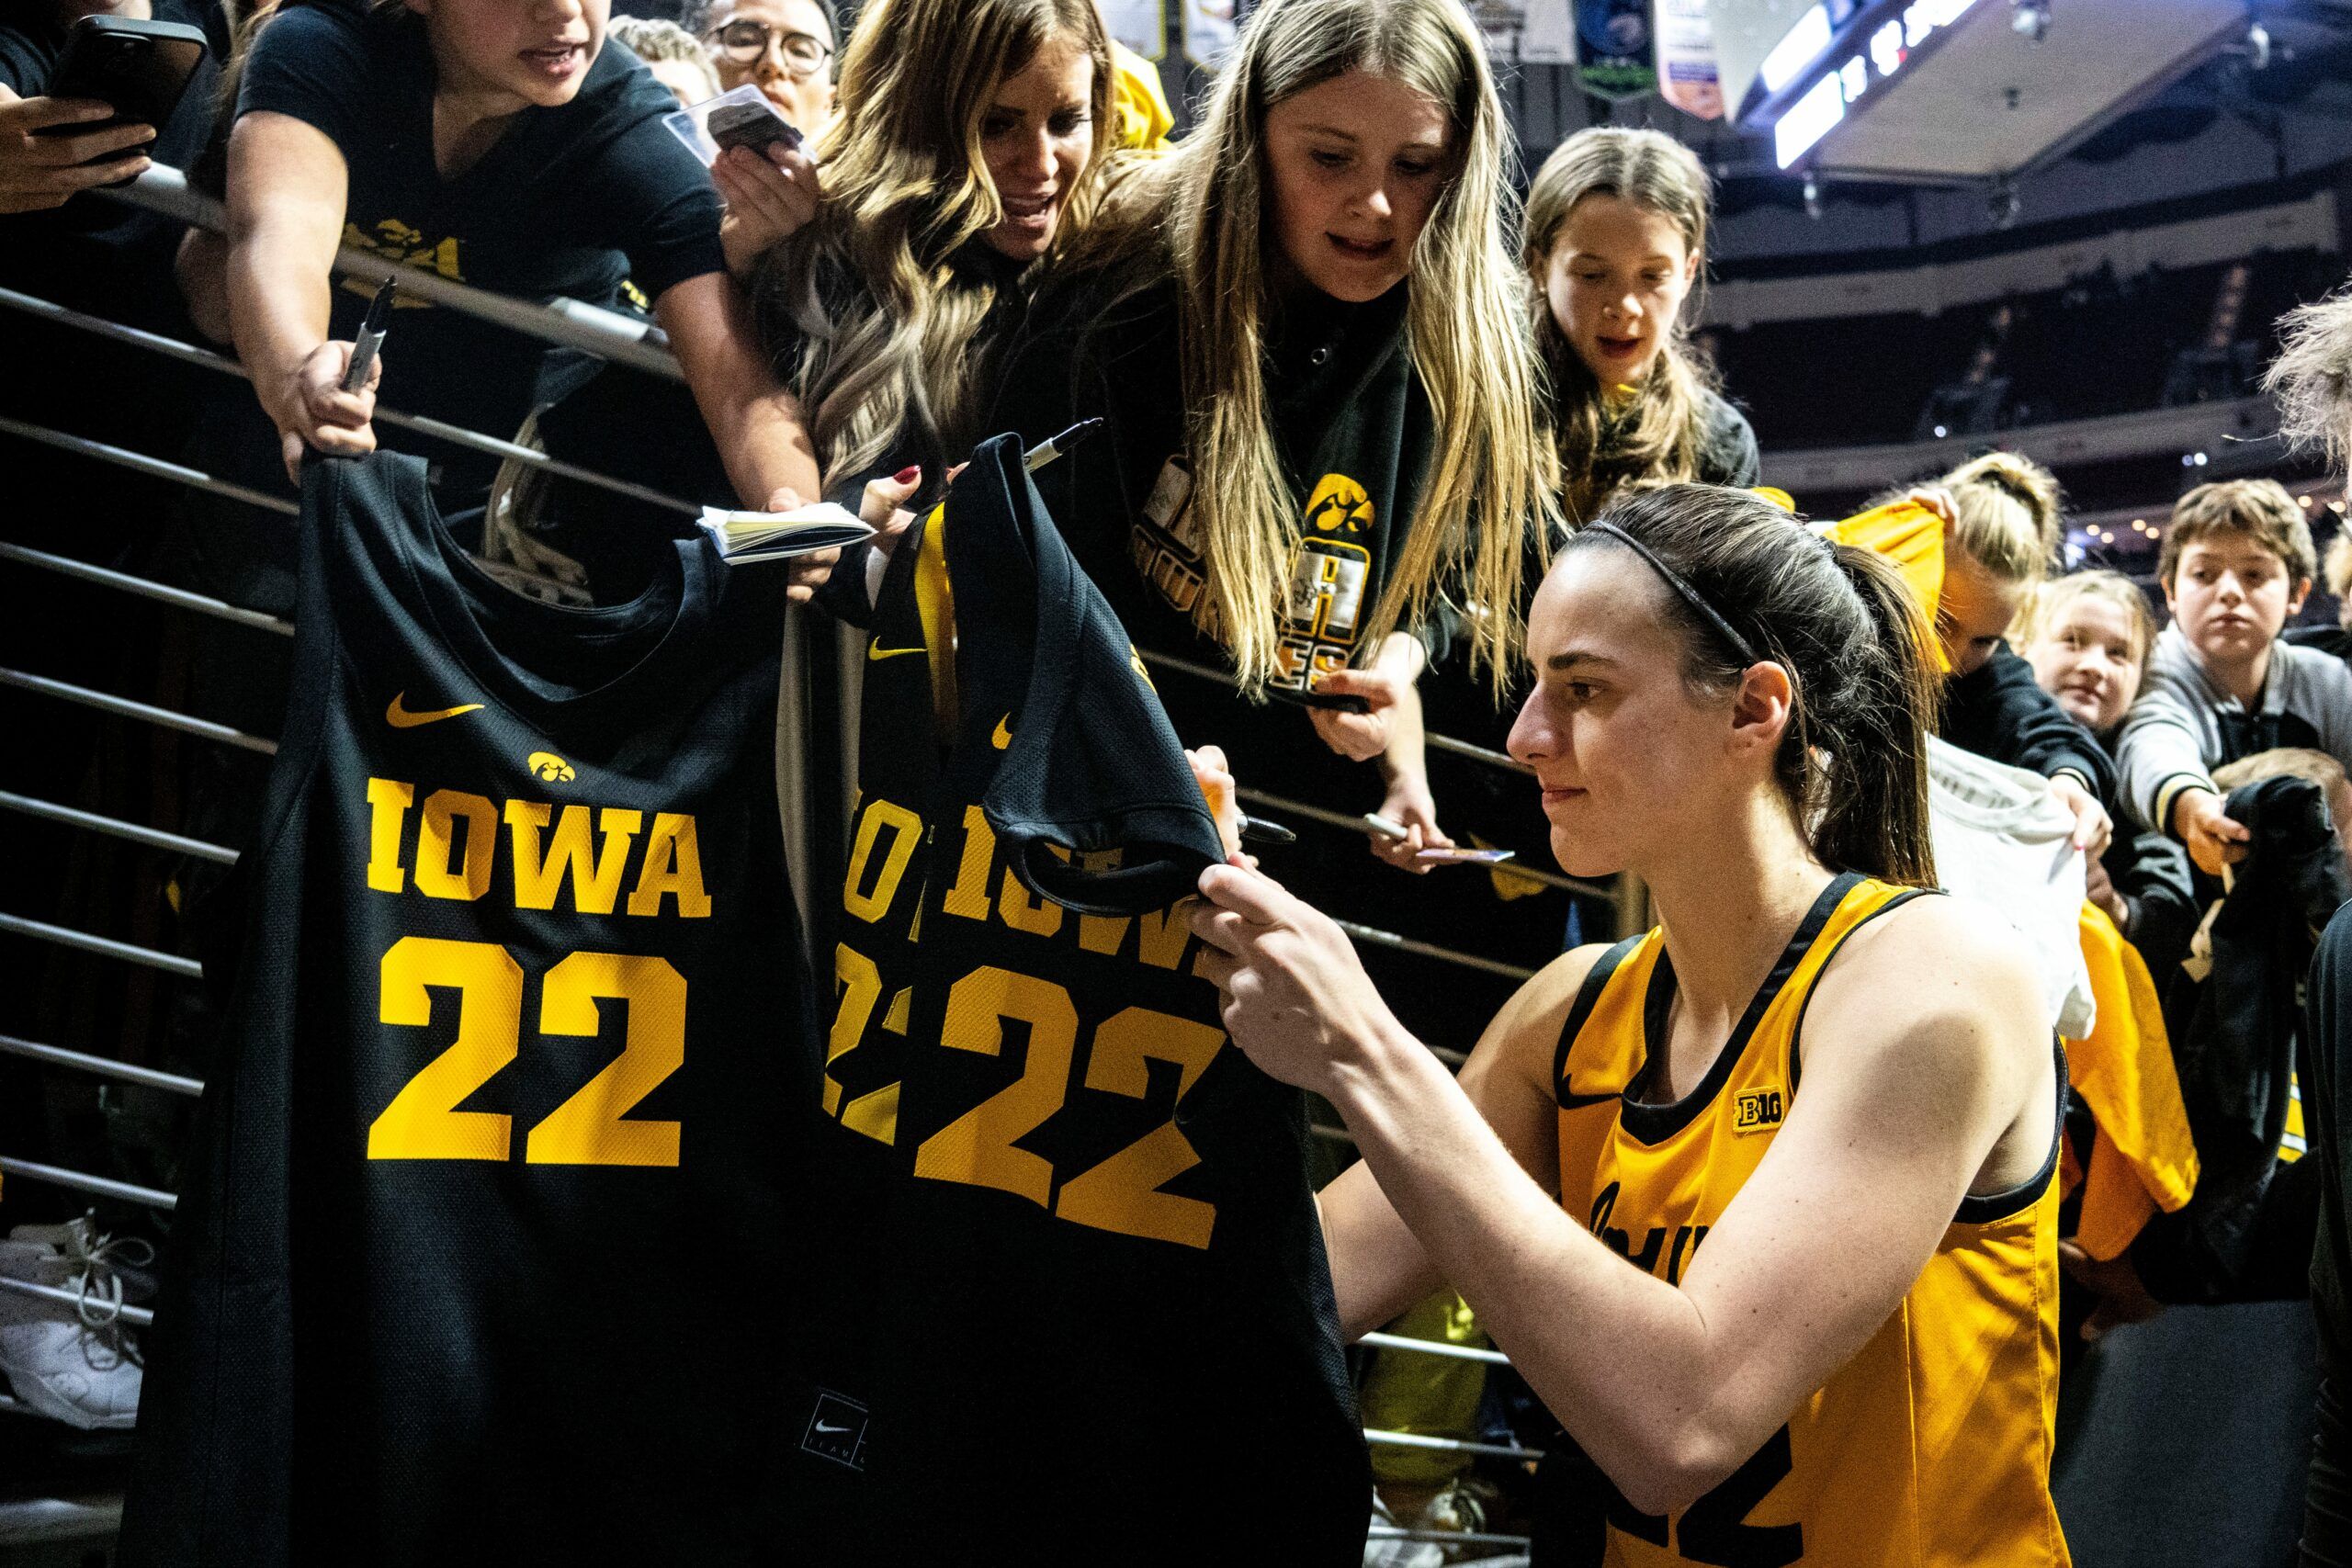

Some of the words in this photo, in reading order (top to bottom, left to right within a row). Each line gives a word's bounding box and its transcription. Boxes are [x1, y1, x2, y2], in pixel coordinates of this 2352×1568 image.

[368, 777, 712, 918] IOWA
[367, 935, 688, 1168] 22
[913, 965, 1227, 1250] 22
